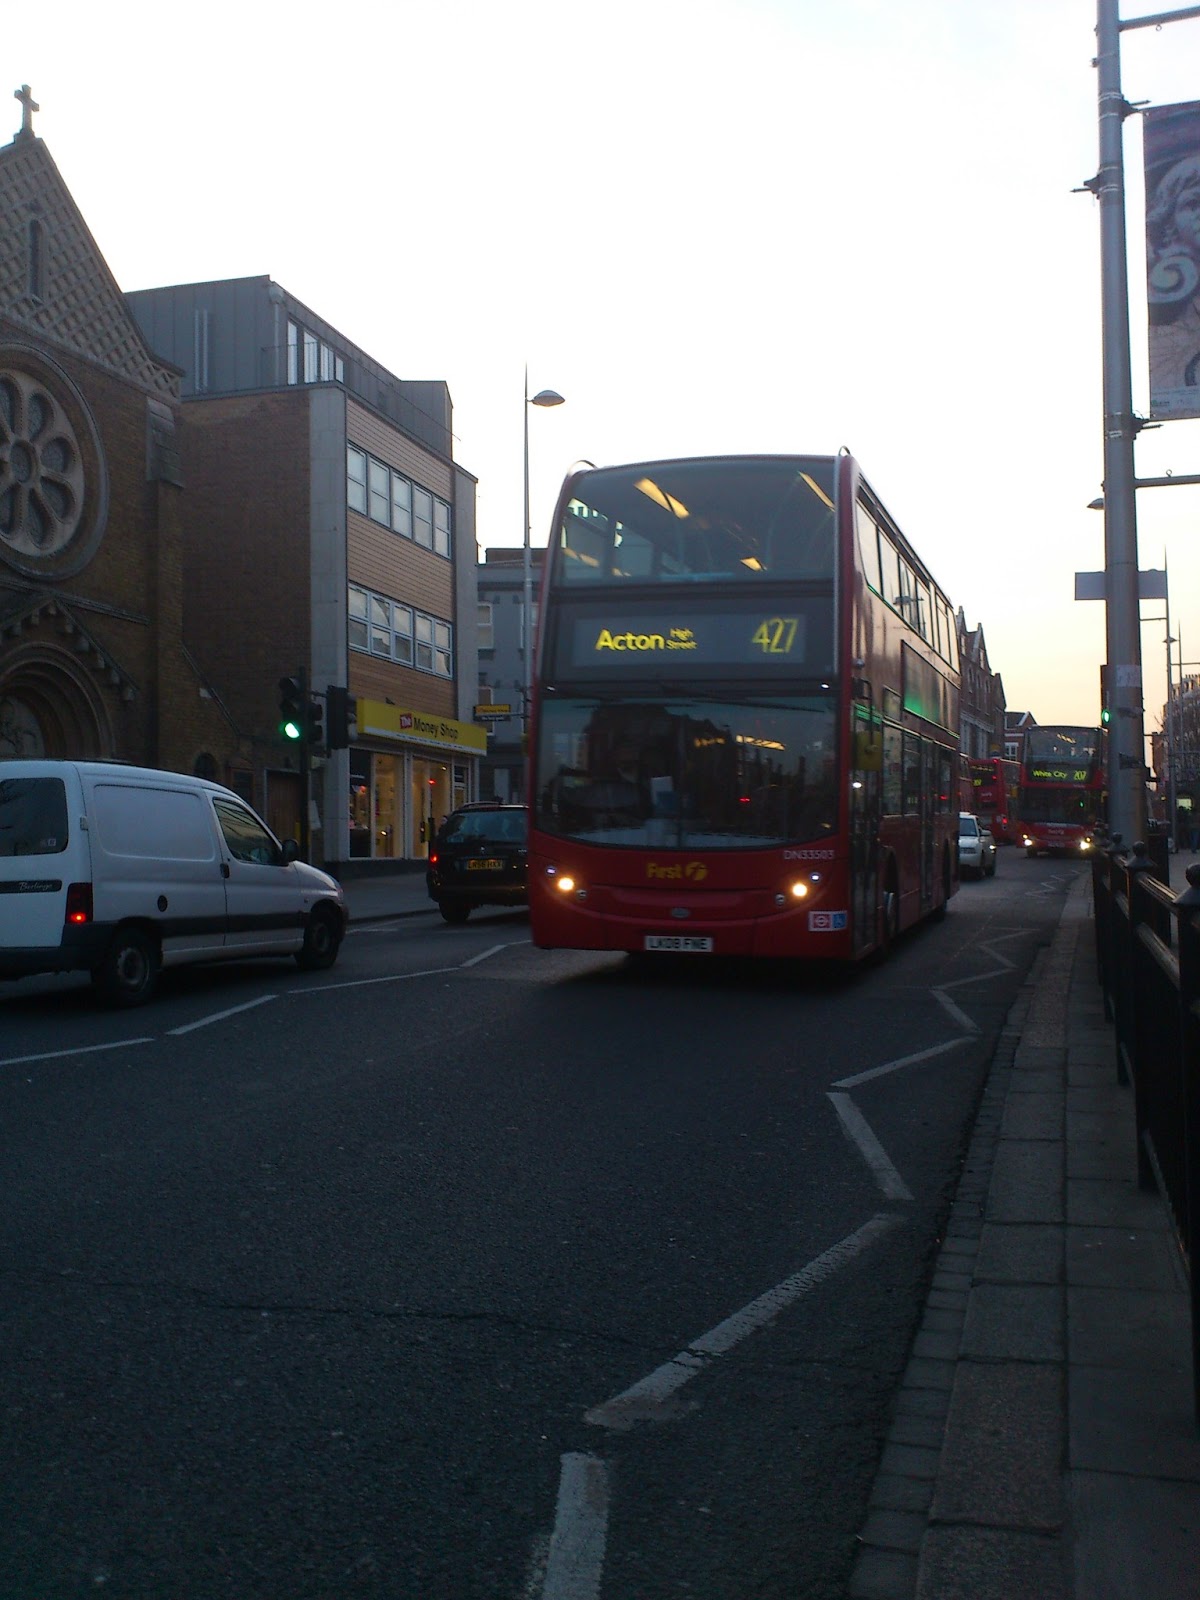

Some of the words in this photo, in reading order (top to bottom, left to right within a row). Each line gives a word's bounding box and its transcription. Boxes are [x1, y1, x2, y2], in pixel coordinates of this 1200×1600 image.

[594, 628, 665, 651] Acton
[669, 628, 694, 641] High
[666, 639, 698, 650] Street
[751, 618, 800, 654] 427
[413, 717, 439, 738] Money
[440, 722, 458, 742] Shop
[1032, 769, 1053, 778] White
[1053, 770, 1068, 779] City
[1073, 770, 1087, 781] 207
[647, 862, 682, 879] First
